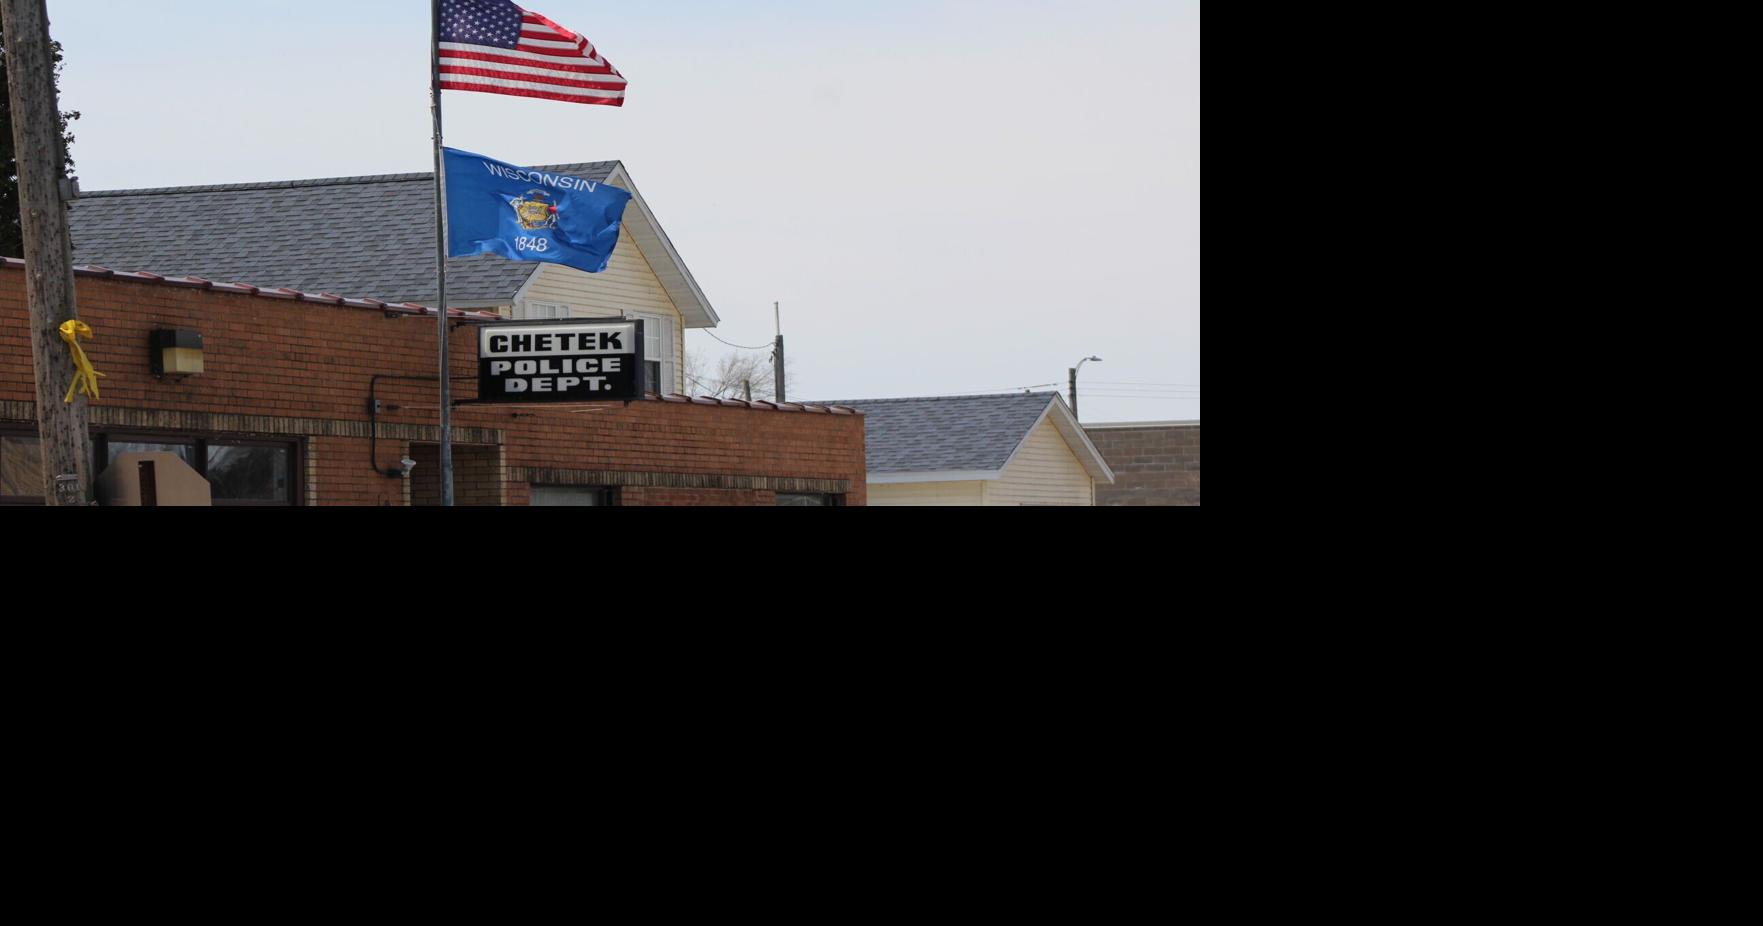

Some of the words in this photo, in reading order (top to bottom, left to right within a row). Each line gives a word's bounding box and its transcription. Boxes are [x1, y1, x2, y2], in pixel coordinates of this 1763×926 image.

[483, 162, 597, 193] WISCONSIN
[514, 236, 548, 252] 1848
[489, 332, 623, 353] CHETEK
[490, 357, 621, 376] POLICE
[504, 376, 612, 393] DEPT.
